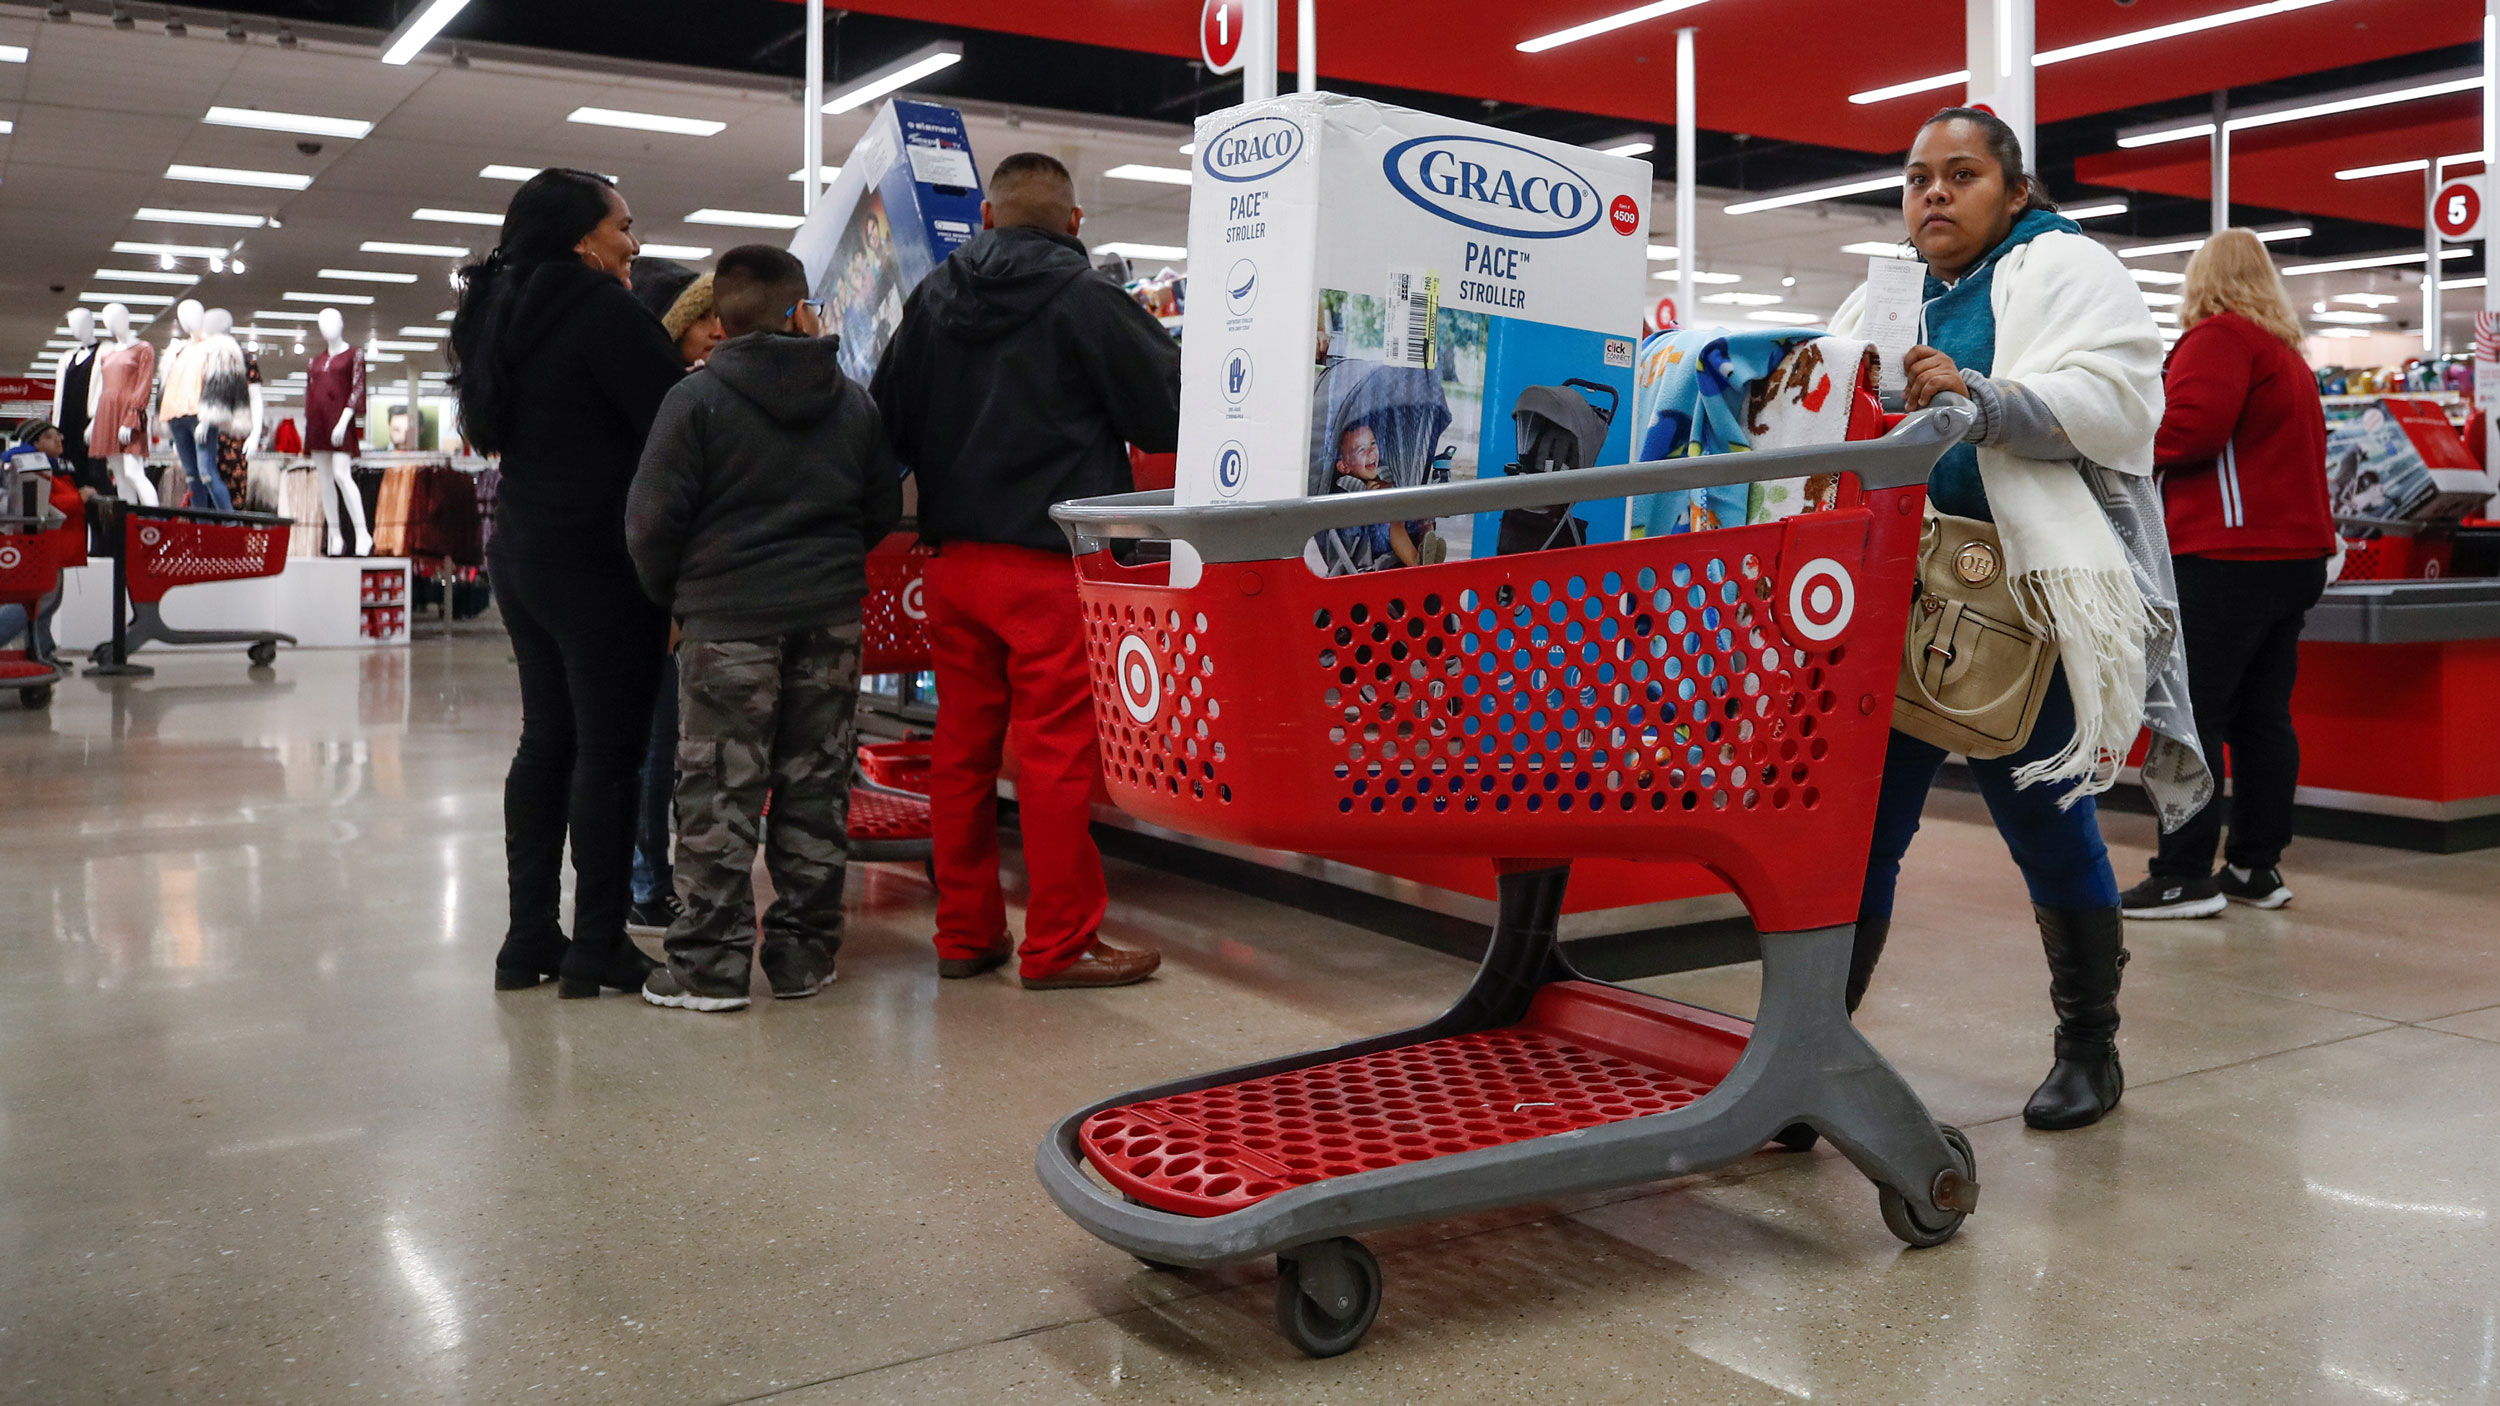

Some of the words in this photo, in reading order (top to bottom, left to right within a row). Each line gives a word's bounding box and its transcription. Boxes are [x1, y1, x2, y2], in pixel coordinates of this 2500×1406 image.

[1216, 3, 1228, 46] 1
[915, 122, 957, 135] element
[1613, 210, 1635, 224] 4509
[2448, 195, 2467, 225] 5
[1226, 222, 1266, 243] STROLLER
[1459, 280, 1526, 310] STROLLER
[1607, 342, 1626, 354] click
